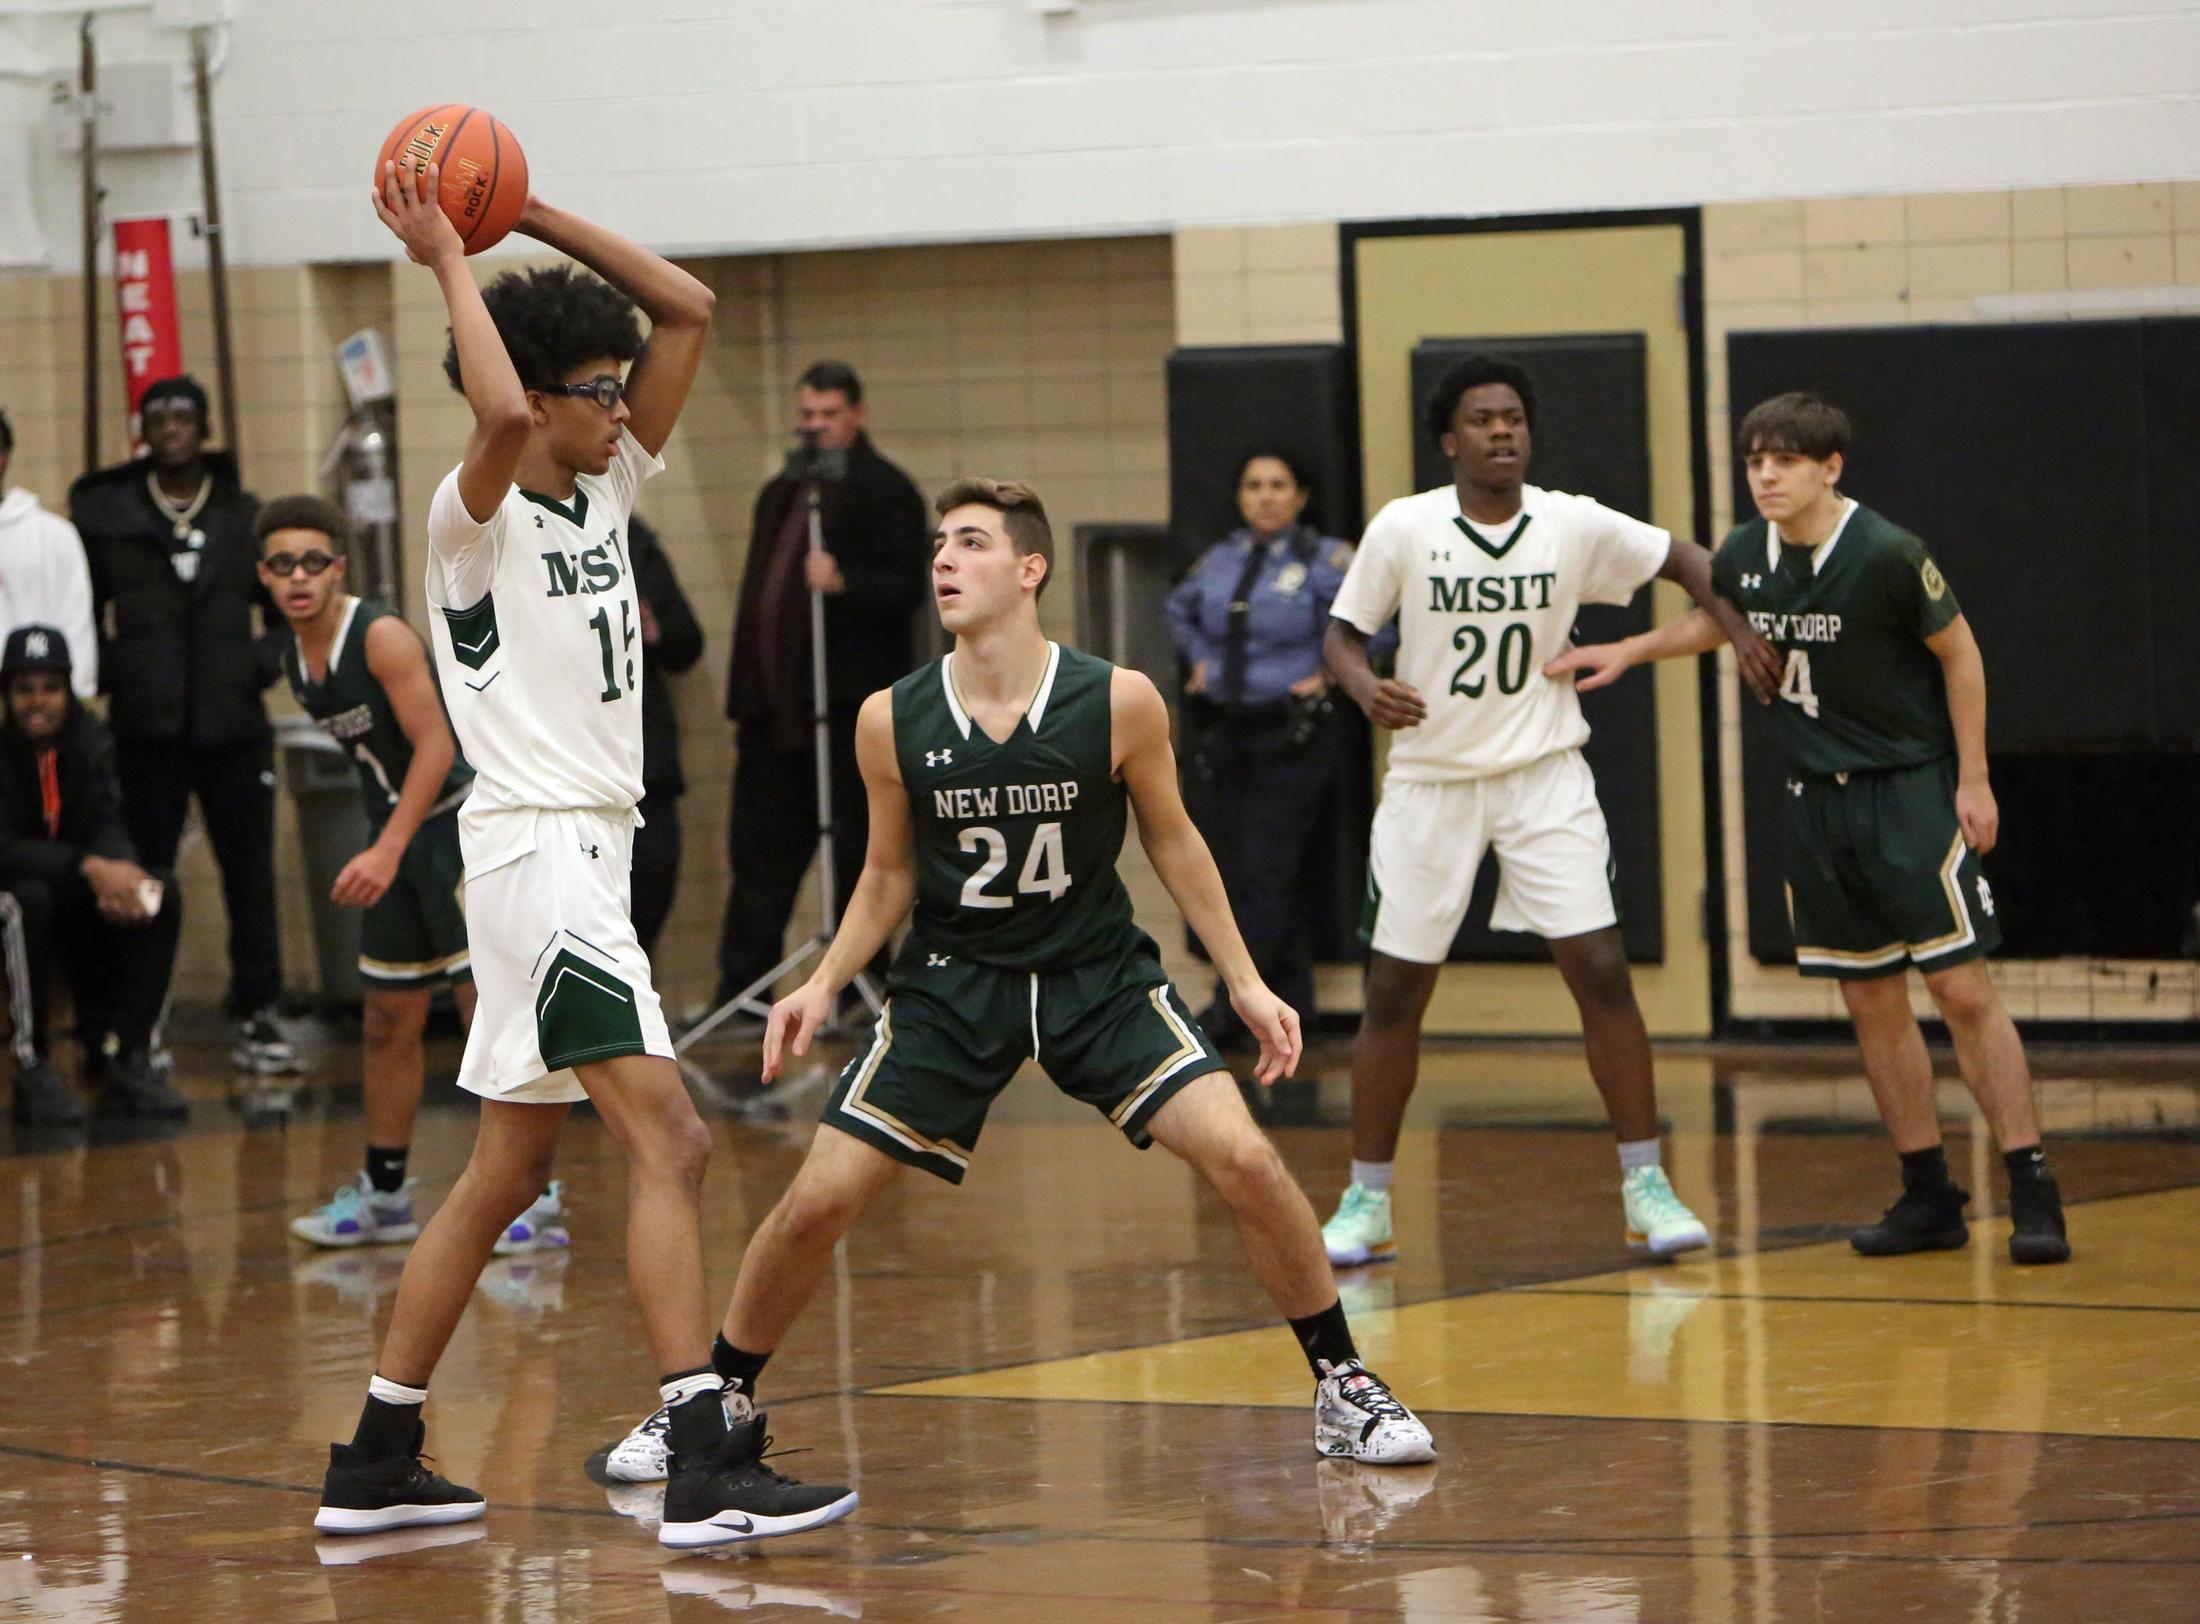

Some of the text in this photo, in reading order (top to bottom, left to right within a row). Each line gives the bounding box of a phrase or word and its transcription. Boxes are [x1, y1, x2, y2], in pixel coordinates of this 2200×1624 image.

[463, 176, 488, 217] ROCK
[1429, 573, 1556, 612] MSIT
[1790, 613, 1841, 642] DORP
[1450, 623, 1532, 699] 20
[934, 781, 1079, 818] NEW DORP
[958, 822, 1072, 909] 24
